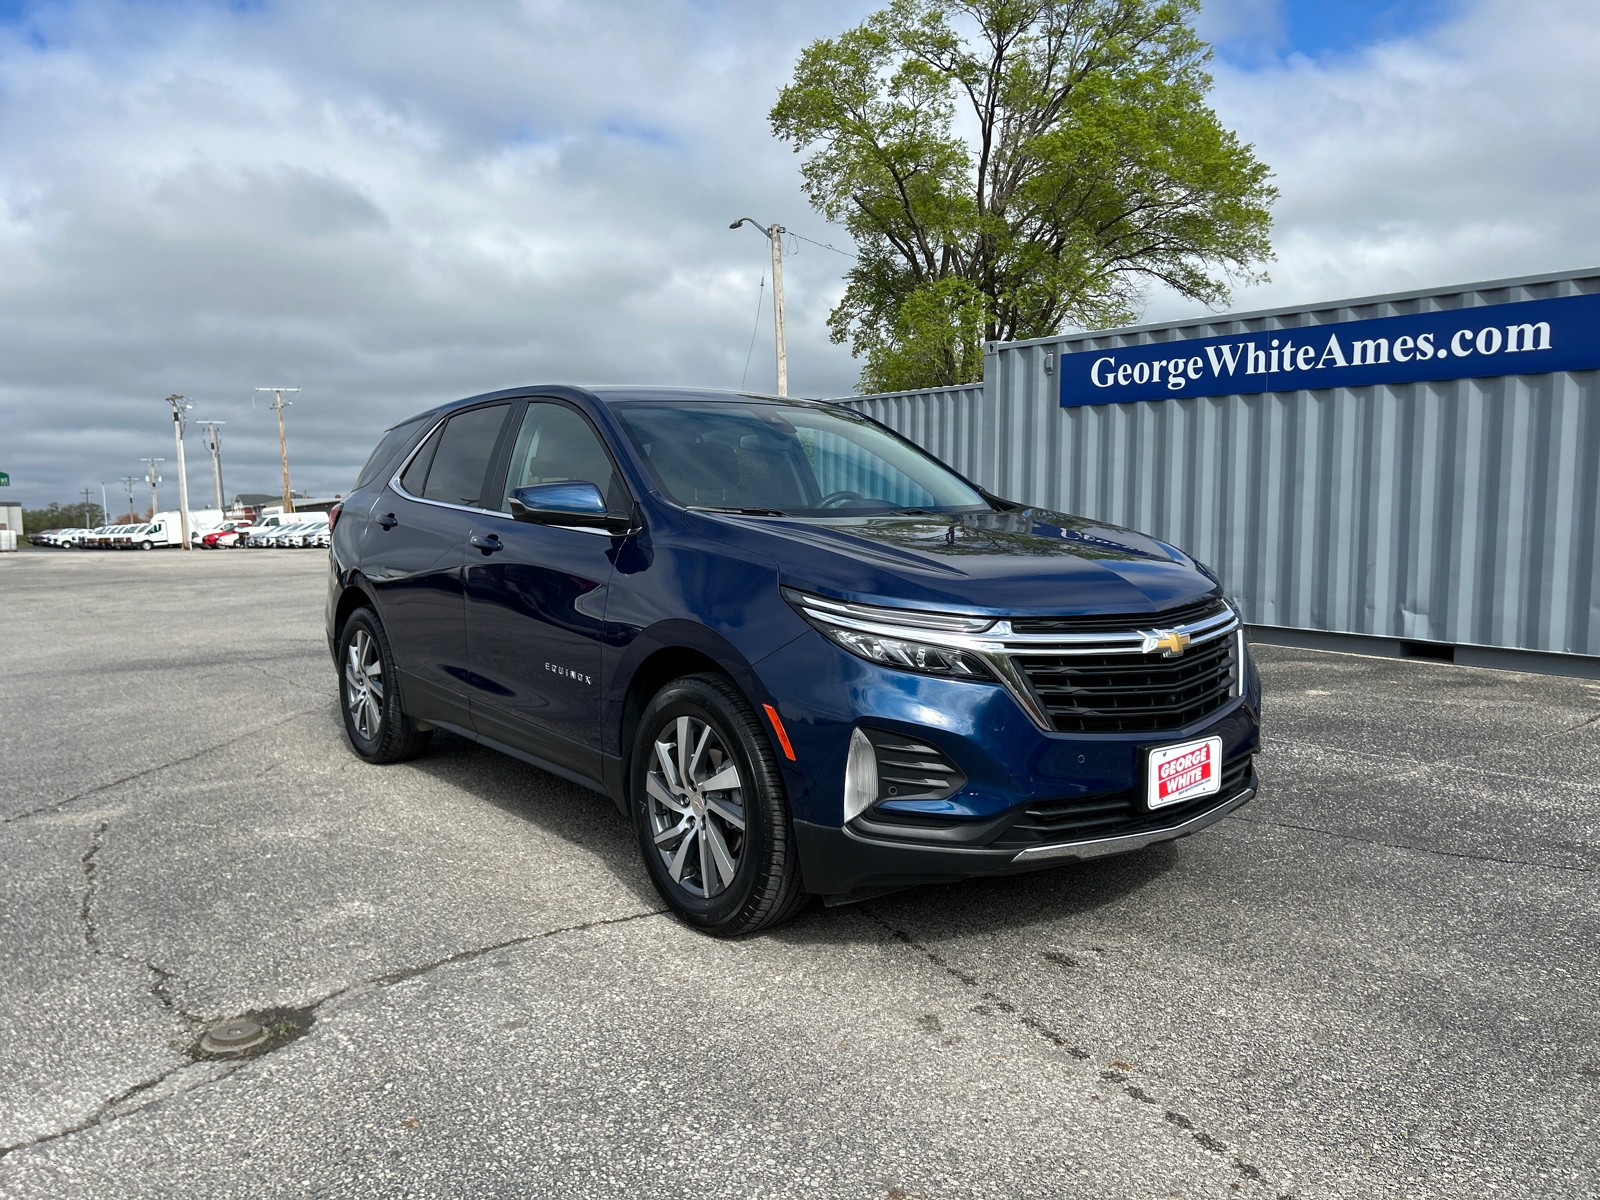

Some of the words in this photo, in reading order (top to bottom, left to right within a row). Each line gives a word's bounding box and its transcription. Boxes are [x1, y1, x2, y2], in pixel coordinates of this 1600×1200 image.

[1090, 321, 1552, 390] GeorgeWhiteAmes.com
[545, 662, 591, 685] EQUINOX
[1161, 748, 1207, 778] GEORGE
[1166, 767, 1202, 793] WHITE
